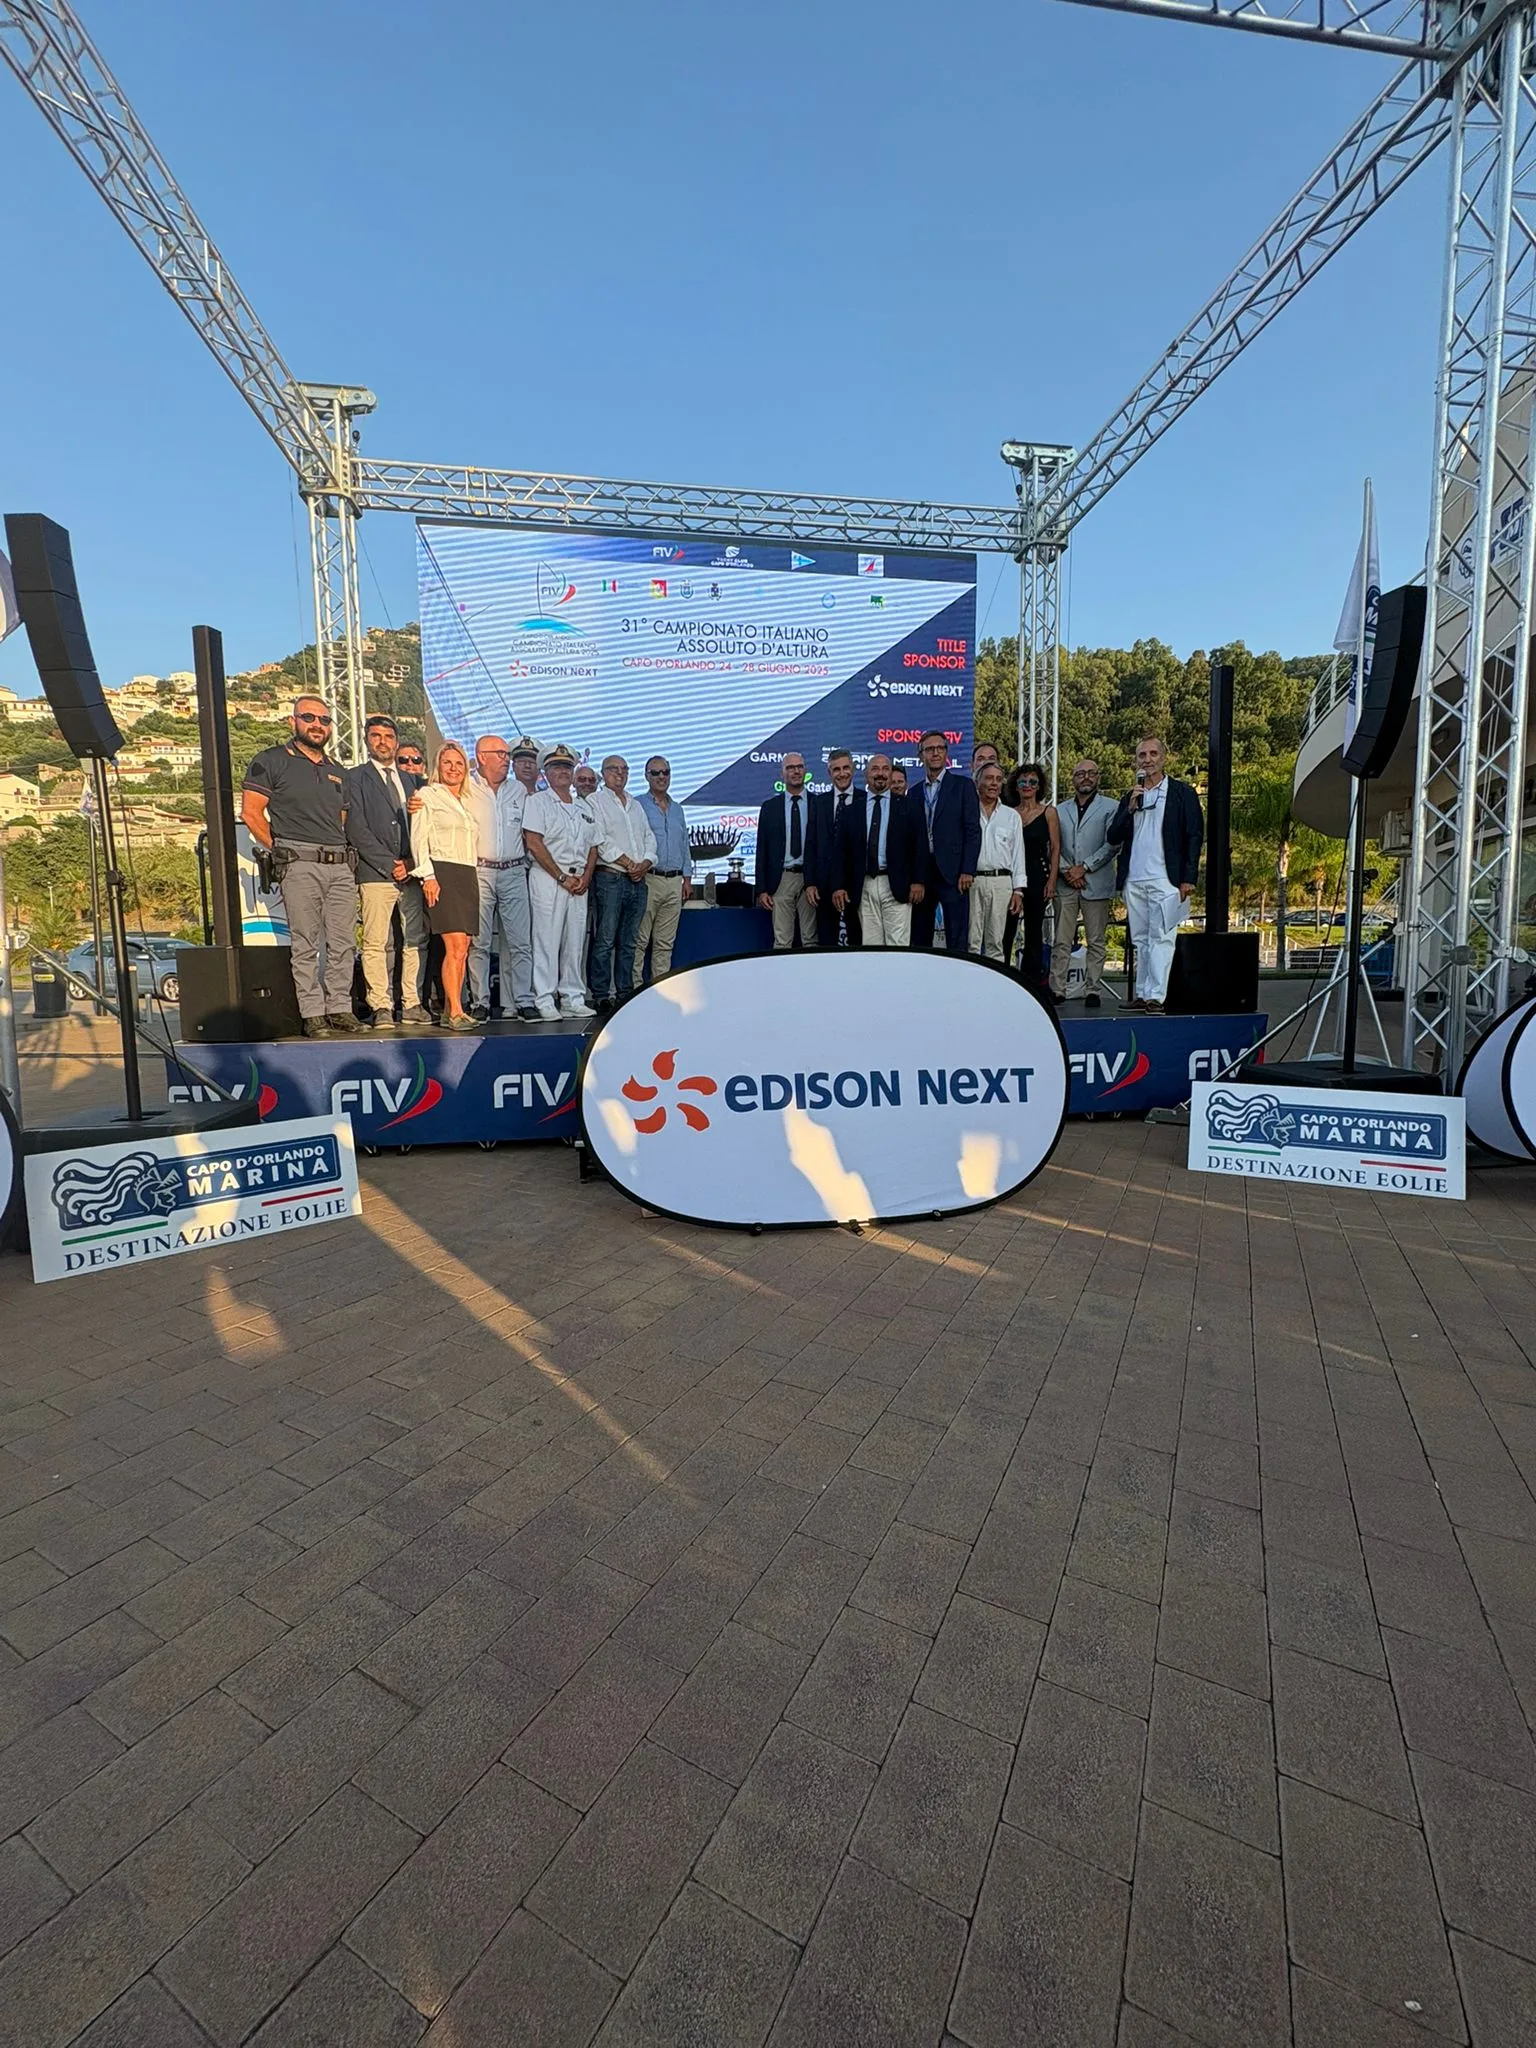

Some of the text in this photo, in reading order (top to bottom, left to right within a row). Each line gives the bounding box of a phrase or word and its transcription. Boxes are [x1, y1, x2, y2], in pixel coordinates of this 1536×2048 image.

[653, 547, 673, 557] FIV
[541, 586, 560, 596] FIV
[621, 617, 829, 642] 31° CAMPIONATO ITALIANO
[677, 639, 829, 658] ASSOLUTO D'ALTURA
[937, 638, 967, 652] TITLE
[622, 657, 652, 667] CAPO
[656, 658, 715, 671] D'ORLANDO
[719, 661, 732, 671] 24
[743, 662, 755, 672] 28
[758, 663, 800, 674] GIUGNO
[804, 664, 829, 675] 2025
[903, 653, 966, 669] SPONSOR
[878, 729, 927, 743] SPONS
[750, 752, 787, 763] GARM
[720, 815, 758, 828] SPON
[1066, 967, 1088, 982] FIV
[1069, 1052, 1127, 1084] FIV
[1189, 1048, 1249, 1080] FIV
[331, 1078, 412, 1114] FIV
[494, 1072, 571, 1108] FIV
[1300, 1113, 1432, 1133] CAPO D'ORLANDO
[1300, 1126, 1434, 1150] MARINA
[187, 1145, 325, 1177] CAPO D'ORLANDO
[188, 1157, 329, 1197] MARINA
[1207, 1155, 1449, 1194] DESTINAZIONE EOLIE
[64, 1199, 348, 1271] DESTINAZIONE EOLIE
